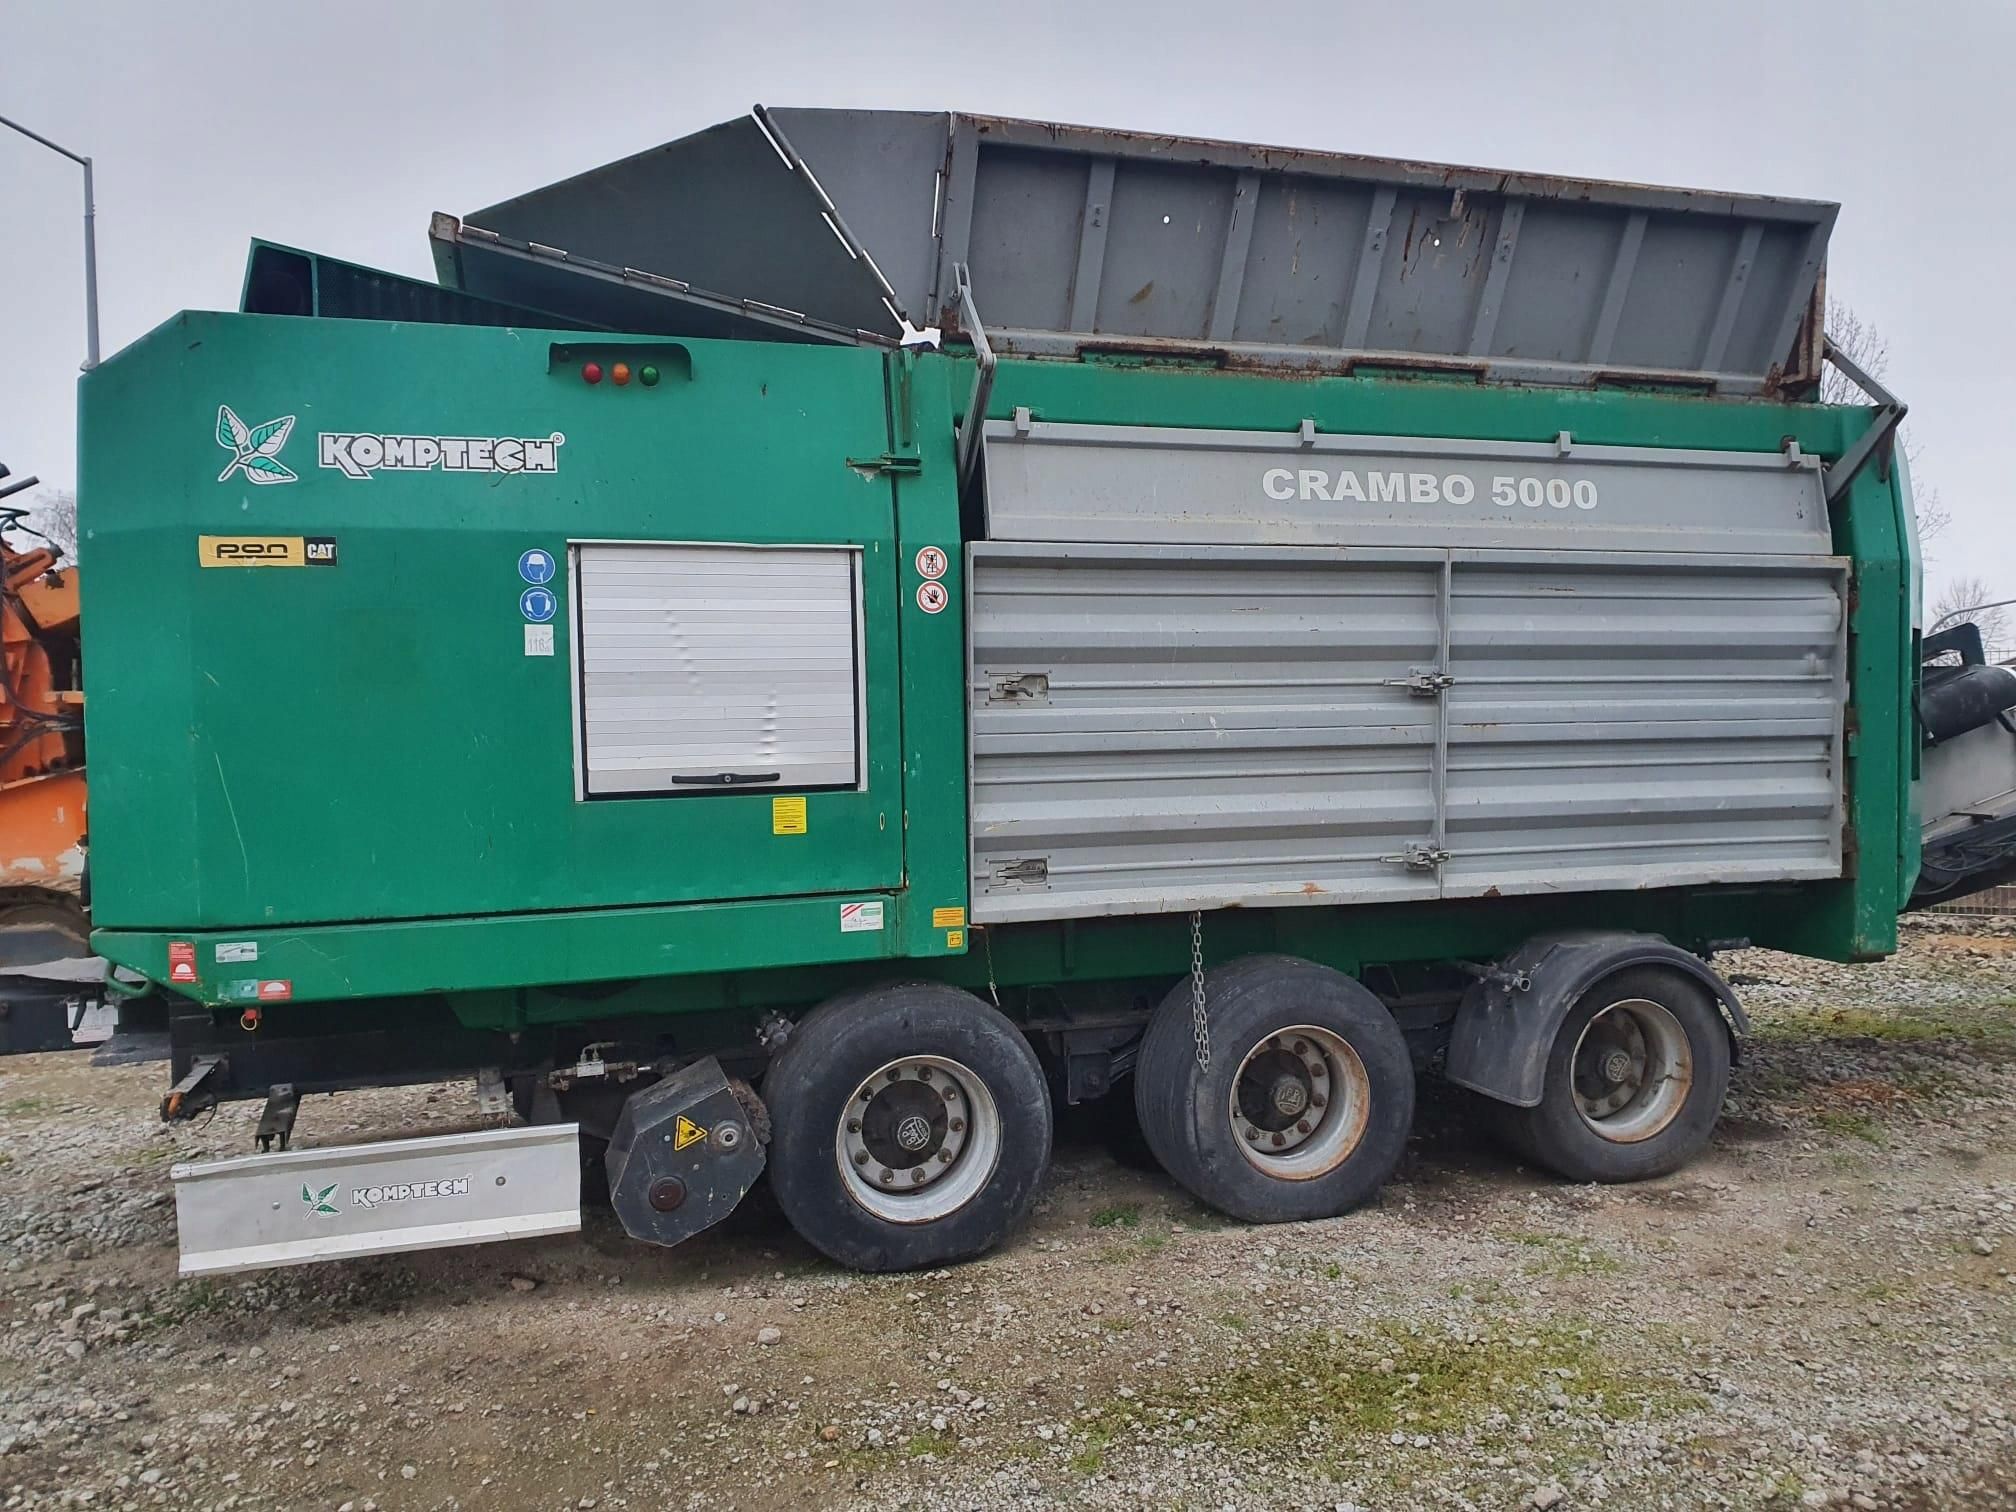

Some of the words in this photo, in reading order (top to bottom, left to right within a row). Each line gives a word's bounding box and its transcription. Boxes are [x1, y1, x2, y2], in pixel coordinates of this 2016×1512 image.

[1262, 468, 1475, 505] CRAMBO
[1491, 476, 1598, 510] 5000
[307, 543, 334, 559] CAT
